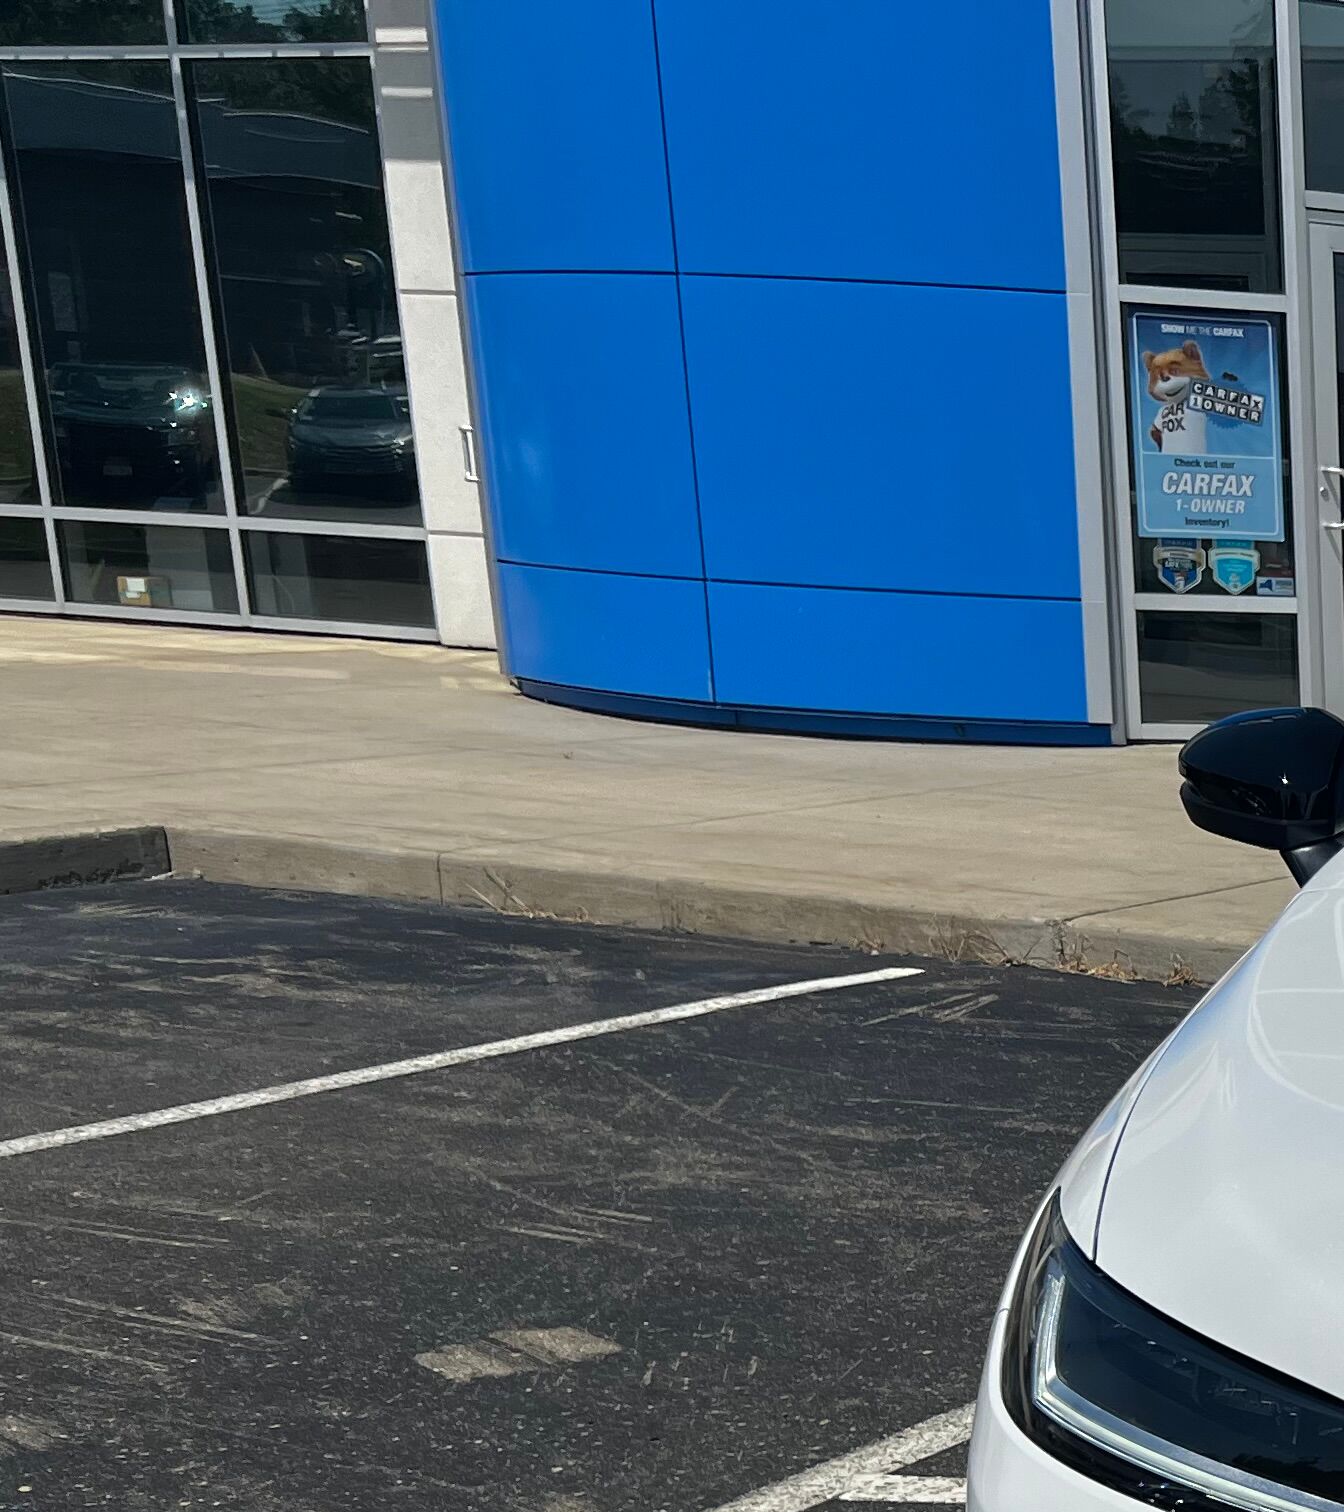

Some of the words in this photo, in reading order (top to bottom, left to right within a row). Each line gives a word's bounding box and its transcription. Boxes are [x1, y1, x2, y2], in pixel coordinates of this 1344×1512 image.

[1160, 323, 1185, 334] SHOW
[1213, 327, 1245, 338] CARFAX
[1193, 382, 1263, 411] CARFAX
[1161, 402, 1185, 420] CAR
[1203, 401, 1261, 421] OWNER
[1161, 417, 1187, 432] FOX
[1174, 458, 1201, 468] Check
[1204, 459, 1218, 469] out
[1162, 471, 1255, 497] CARFAX
[1176, 498, 1245, 514] 1-OWNER
[1185, 516, 1230, 528] Inventory!
